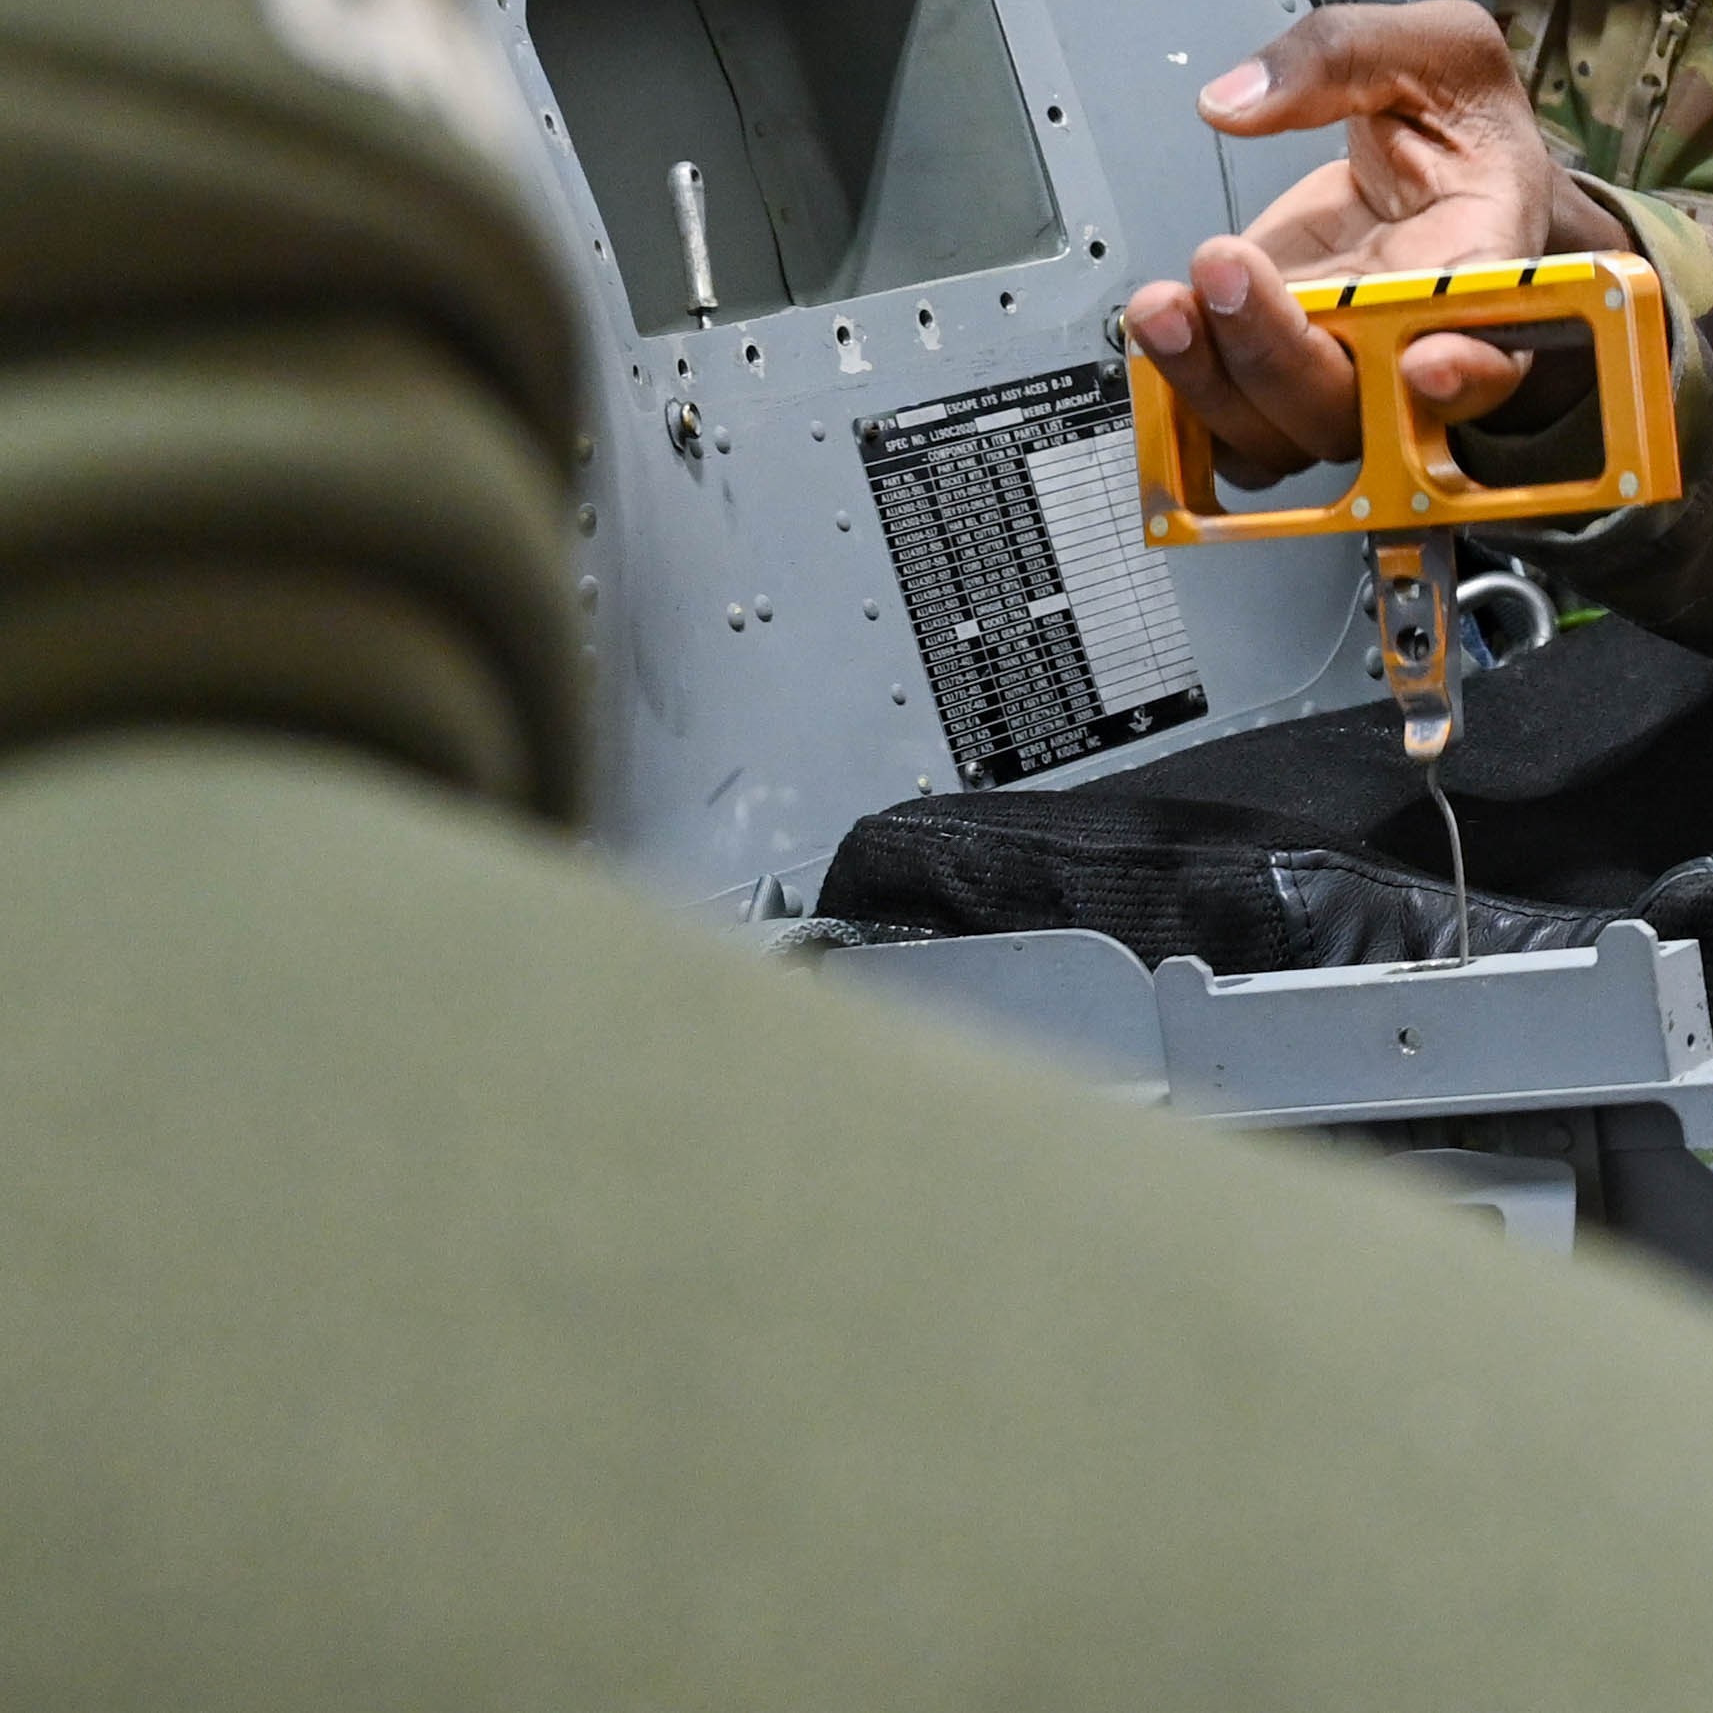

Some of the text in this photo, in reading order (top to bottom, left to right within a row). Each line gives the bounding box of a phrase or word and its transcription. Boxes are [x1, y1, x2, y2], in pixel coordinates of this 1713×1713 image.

[946, 398, 979, 415] ESCAPE
[981, 394, 998, 407] SYS
[885, 437, 909, 452] SPEC
[1022, 402, 1052, 418] WEBER
[1055, 389, 1100, 412] AIRCRAFT
[991, 433, 1011, 446] ITEM
[1013, 425, 1041, 440] PARTS
[882, 476, 901, 488] PART
[936, 462, 955, 474] PART
[1018, 726, 1088, 758] WEBER AIRCRAFT
[1041, 751, 1052, 764] OF
